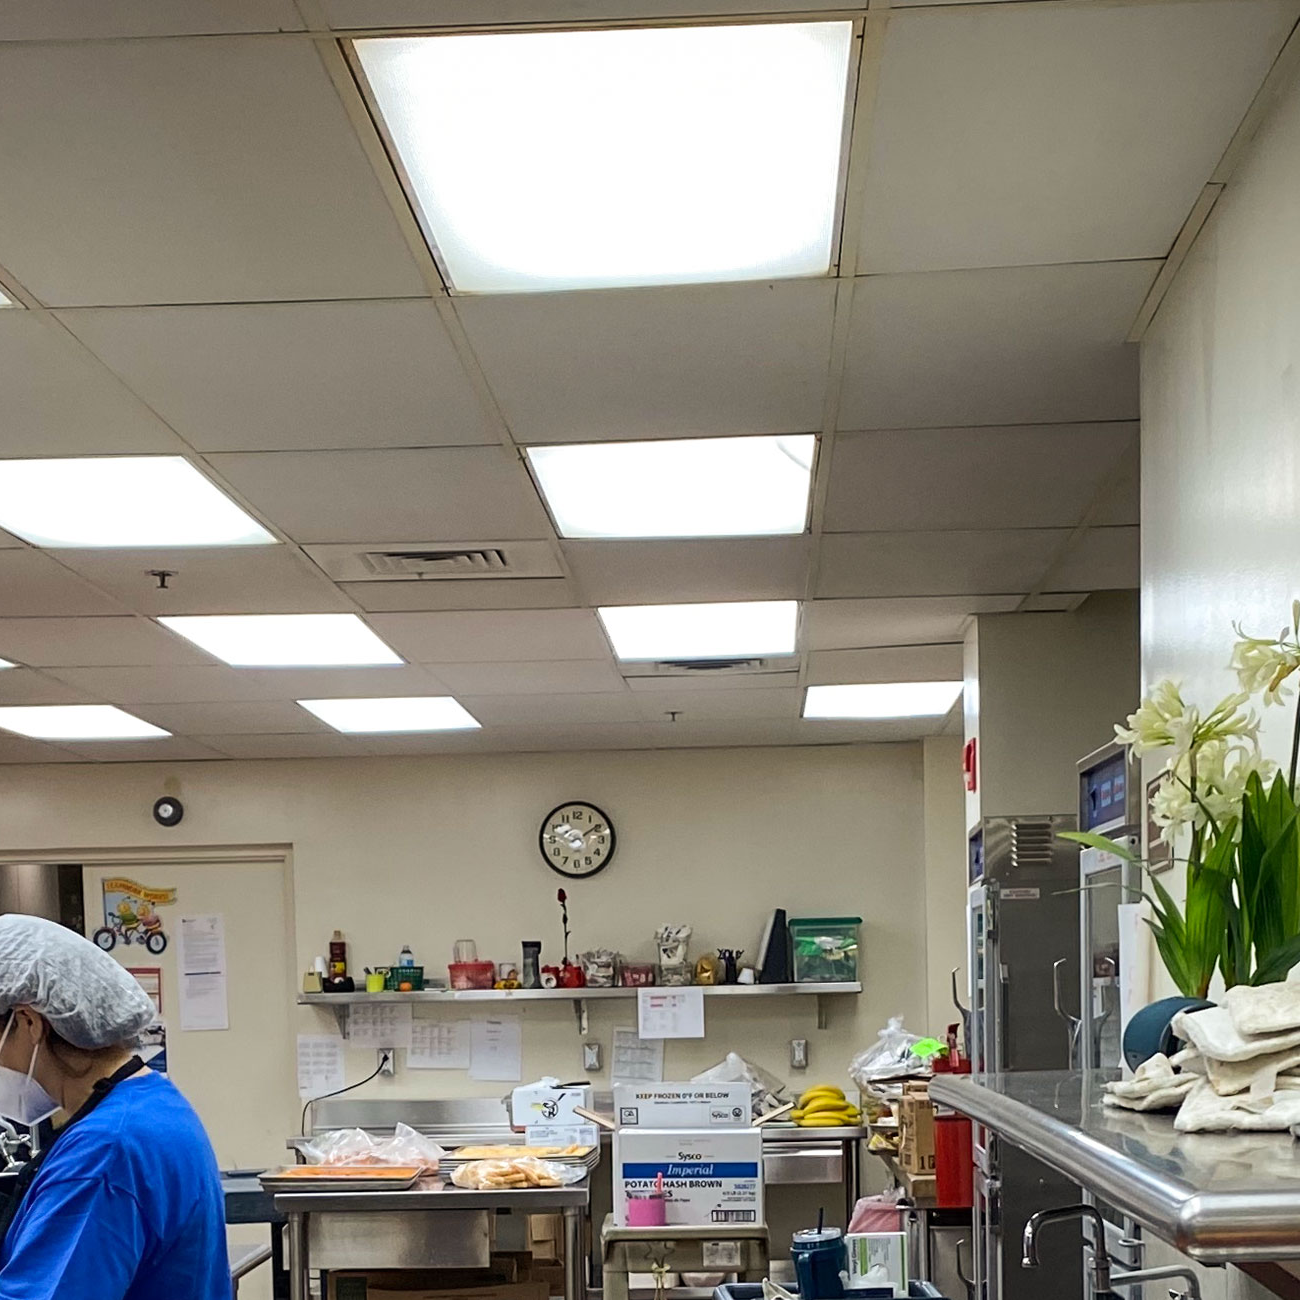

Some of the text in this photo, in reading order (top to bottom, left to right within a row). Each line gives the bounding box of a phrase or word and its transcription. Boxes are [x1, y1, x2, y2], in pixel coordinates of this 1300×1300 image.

[562, 814, 569, 823] 11
[572, 811, 583, 820] 12
[588, 815, 592, 824] 1
[598, 836, 605, 844] 3
[593, 848, 600, 857] 4
[562, 856, 569, 865] 7
[584, 856, 592, 865] 5
[678, 1152, 702, 1162] Sysco
[666, 1164, 714, 1176] Imperial
[662, 1180, 687, 1188] HASH
[689, 1180, 722, 1188] BROWN
